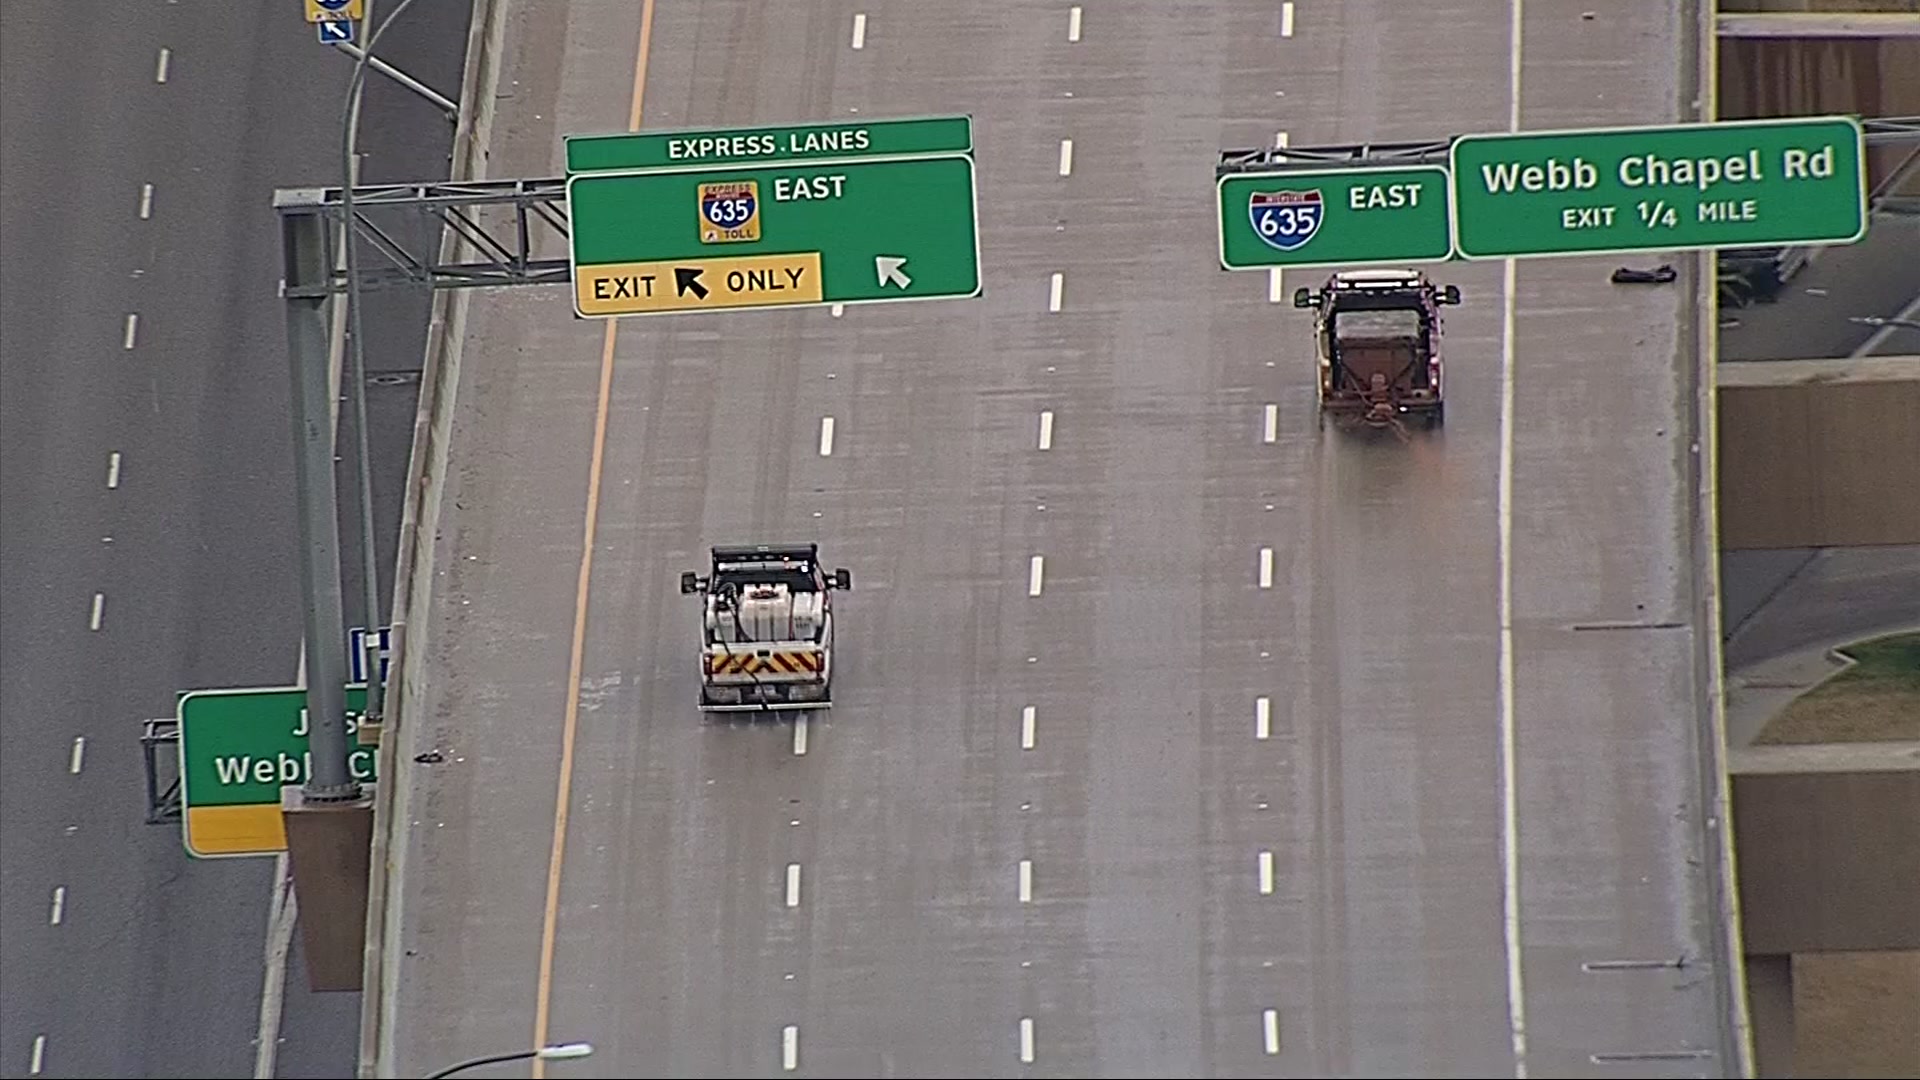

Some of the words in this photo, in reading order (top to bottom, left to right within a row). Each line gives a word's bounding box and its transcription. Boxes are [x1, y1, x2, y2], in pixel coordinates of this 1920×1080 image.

[669, 136, 775, 159] EXPRESS
[790, 131, 870, 154] LANES
[1482, 156, 1597, 194] Webb
[1618, 149, 1761, 190] Chapel
[1785, 146, 1833, 180] Rd
[705, 184, 751, 194] EXPRESS
[774, 176, 846, 202] EAST
[1350, 184, 1422, 209] EAST
[710, 199, 749, 222] 635
[1260, 207, 1315, 236] 635
[1562, 207, 1616, 230] EXIT
[1697, 200, 1758, 223] MILE
[724, 230, 754, 239] TOLL
[594, 277, 656, 300] EXIT
[727, 268, 804, 292] ONLY
